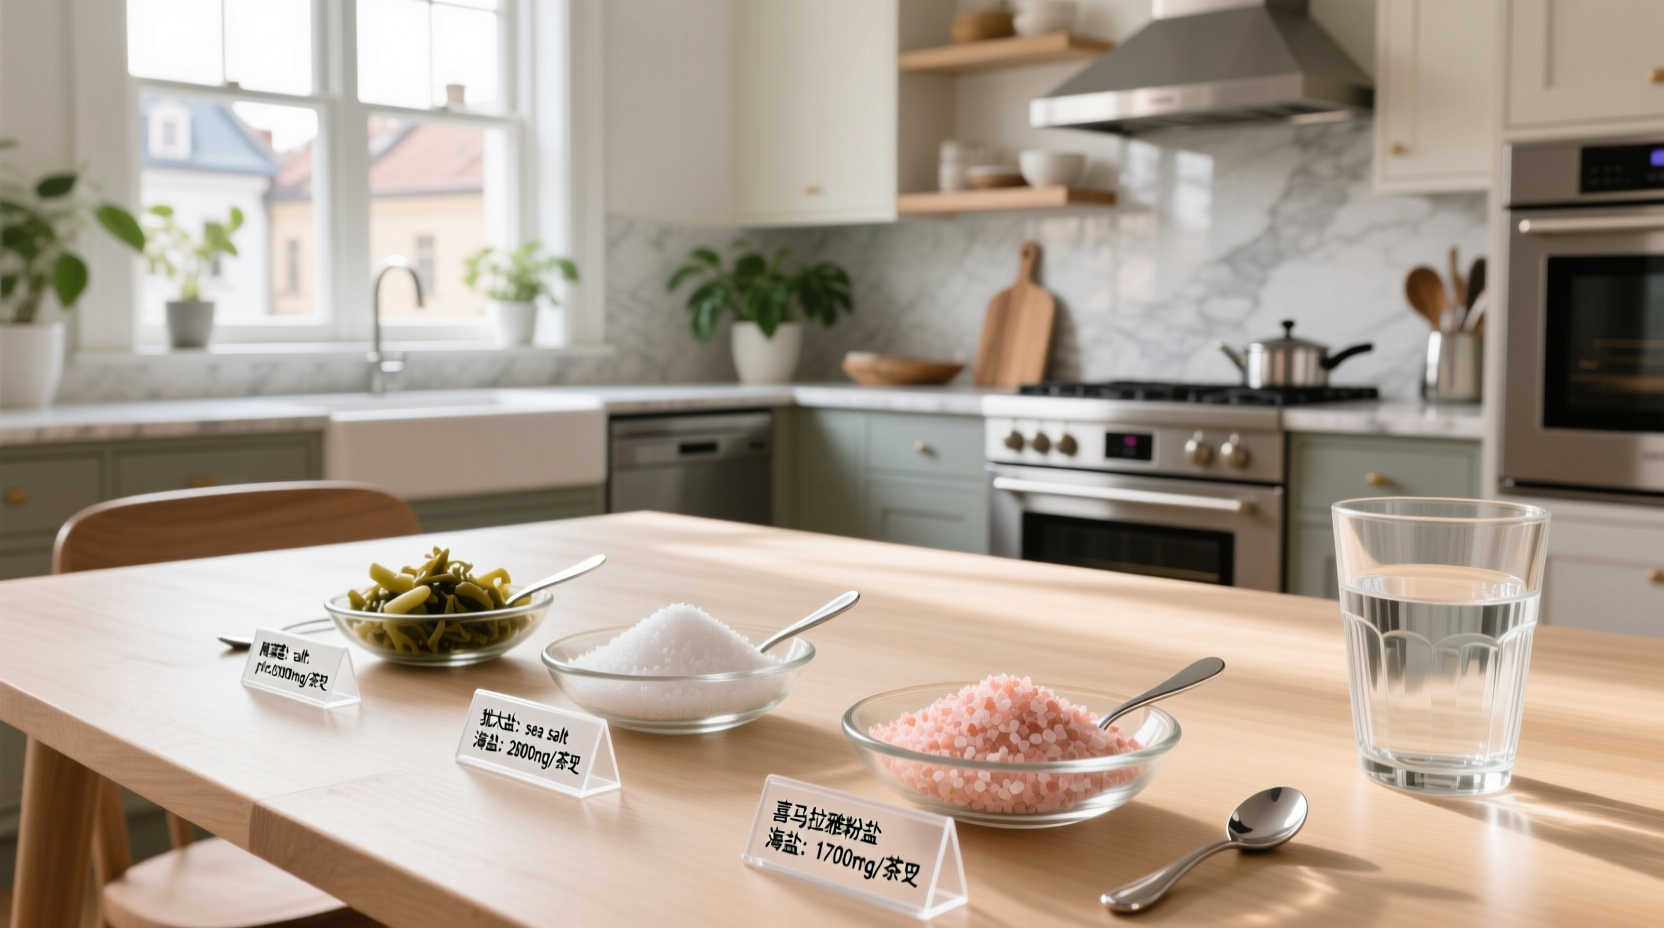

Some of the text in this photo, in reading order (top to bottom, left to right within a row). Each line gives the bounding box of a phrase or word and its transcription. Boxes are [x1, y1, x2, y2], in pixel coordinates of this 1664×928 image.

[525, 723, 544, 739] sea
[546, 727, 569, 745] salt
[773, 799, 882, 845] 喜马拉雅粉盐
